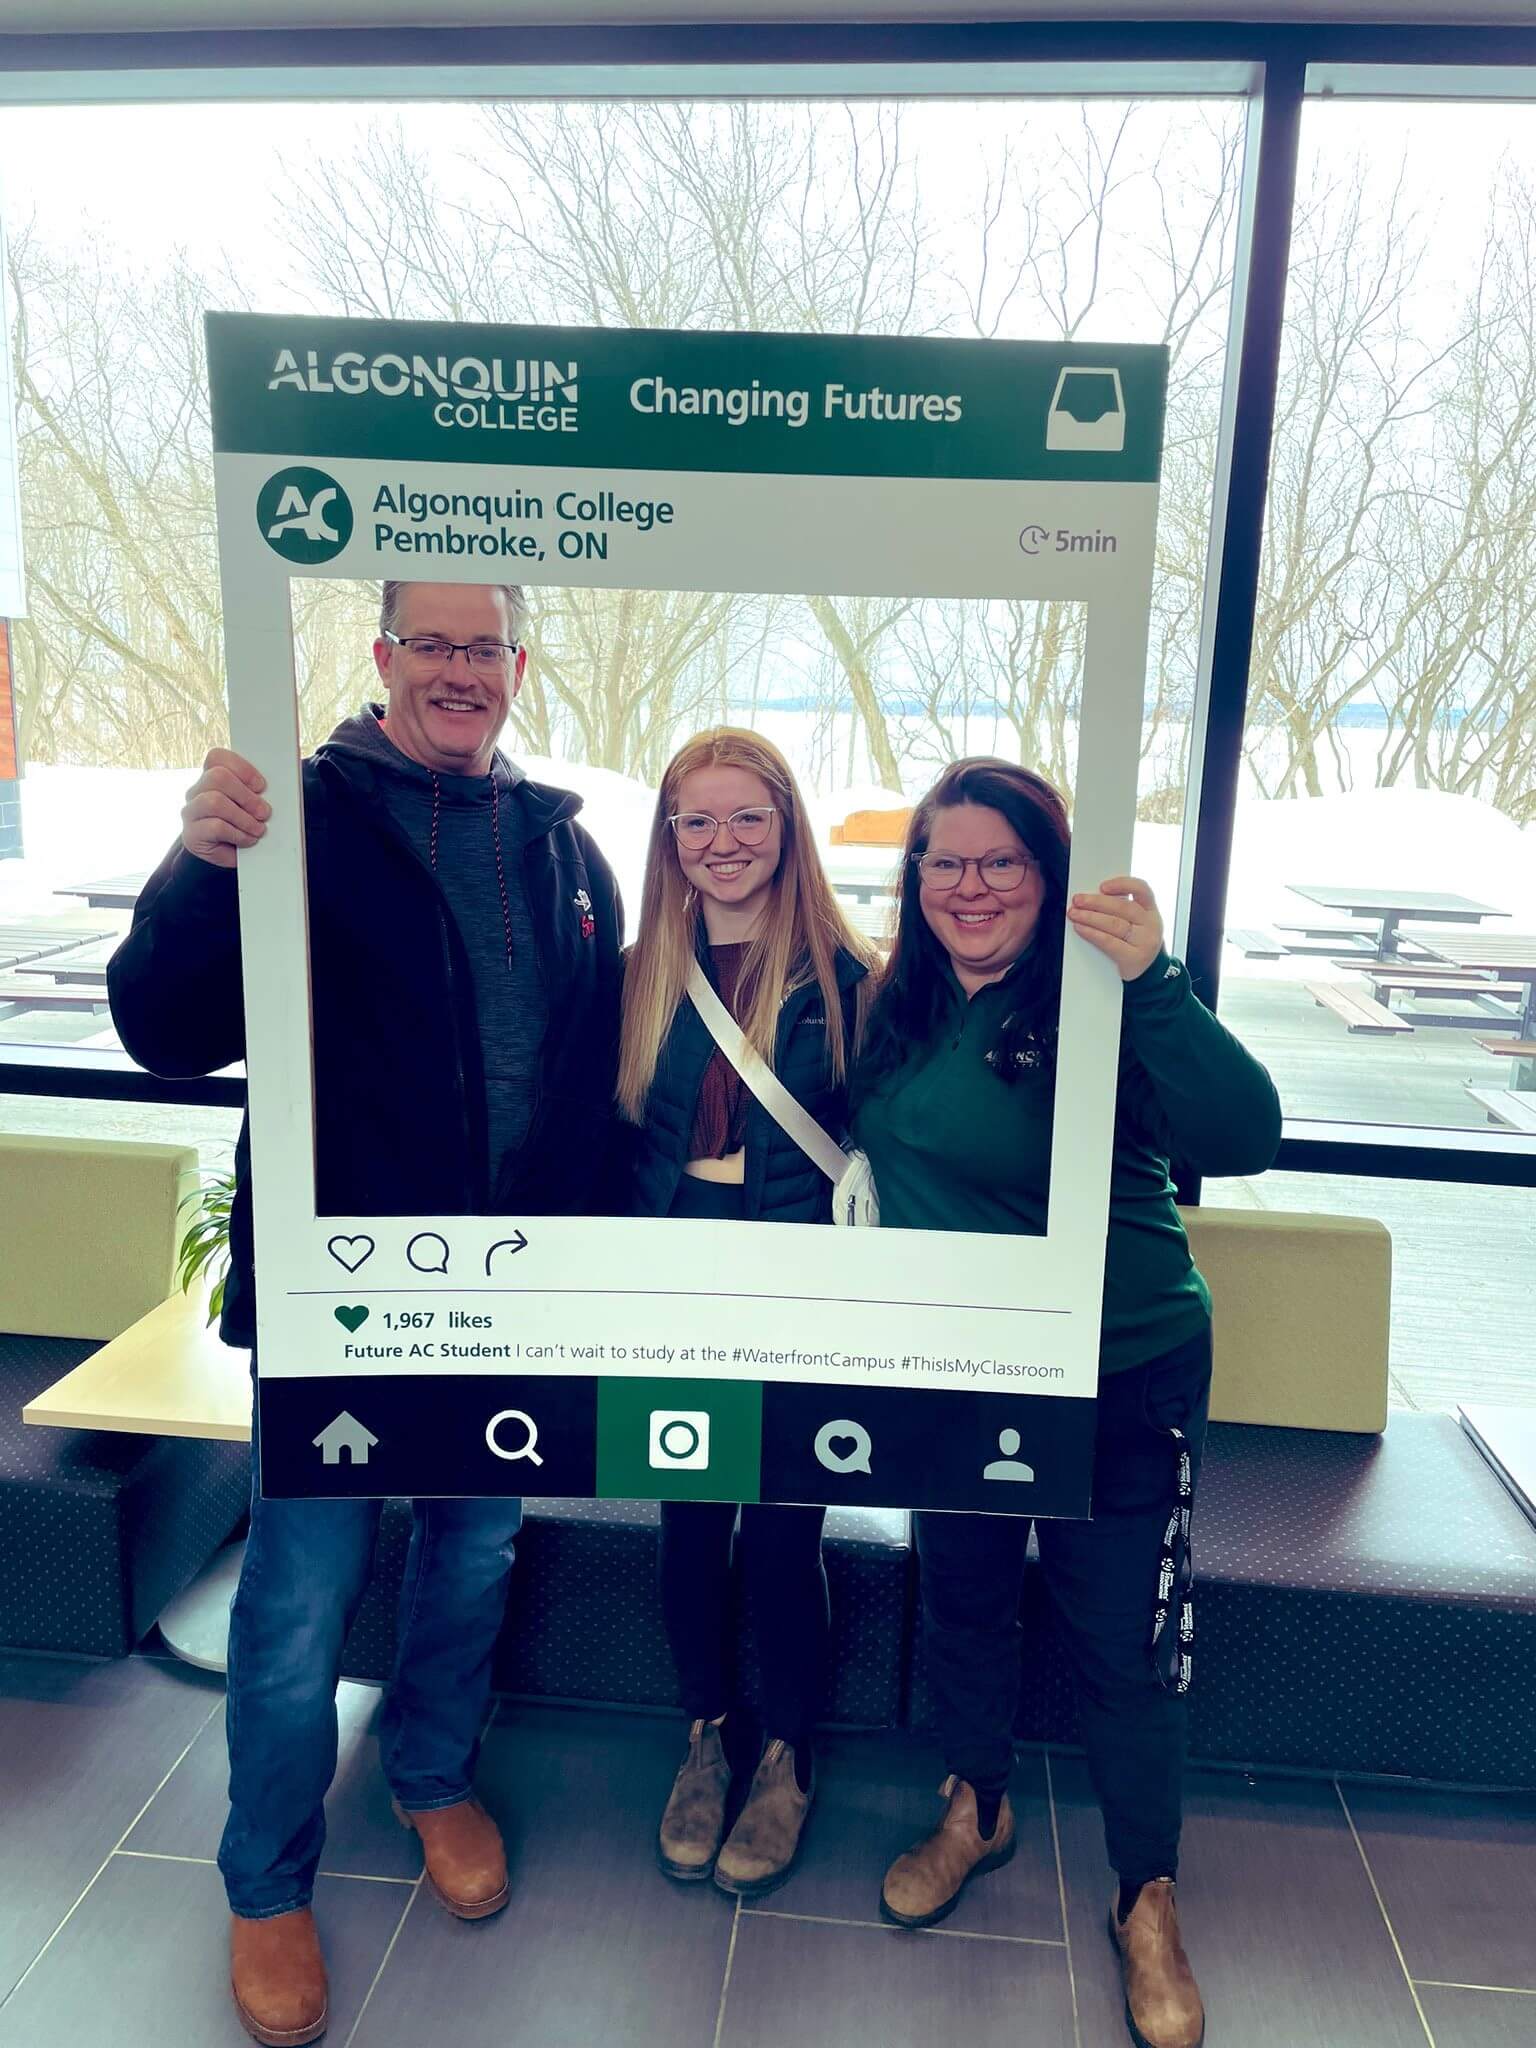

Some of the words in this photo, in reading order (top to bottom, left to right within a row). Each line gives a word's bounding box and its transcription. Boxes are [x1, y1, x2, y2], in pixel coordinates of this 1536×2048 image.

[268, 349, 578, 402] ALGONQUIN
[433, 402, 579, 432] COLLEGE
[629, 375, 808, 427] Changing
[824, 383, 962, 422] Futures
[268, 485, 339, 542] AC
[373, 484, 543, 525] Algonquin
[555, 491, 674, 530] College
[375, 523, 546, 562] Pembroke,
[557, 530, 608, 560] ON
[1055, 529, 1117, 553] 5min
[383, 1312, 435, 1330] 1,967
[449, 1311, 493, 1329] likes
[345, 1344, 403, 1359] Future
[408, 1343, 435, 1358] AC
[440, 1342, 511, 1358] Student
[525, 1343, 566, 1359] can't
[570, 1343, 605, 1359] wait
[610, 1345, 627, 1359] to
[632, 1344, 676, 1364] study
[679, 1347, 696, 1361] at
[700, 1345, 727, 1362] the
[731, 1347, 896, 1372] #WaterfrontCampus
[901, 1355, 1065, 1379] #ThisIsMyClassroom
